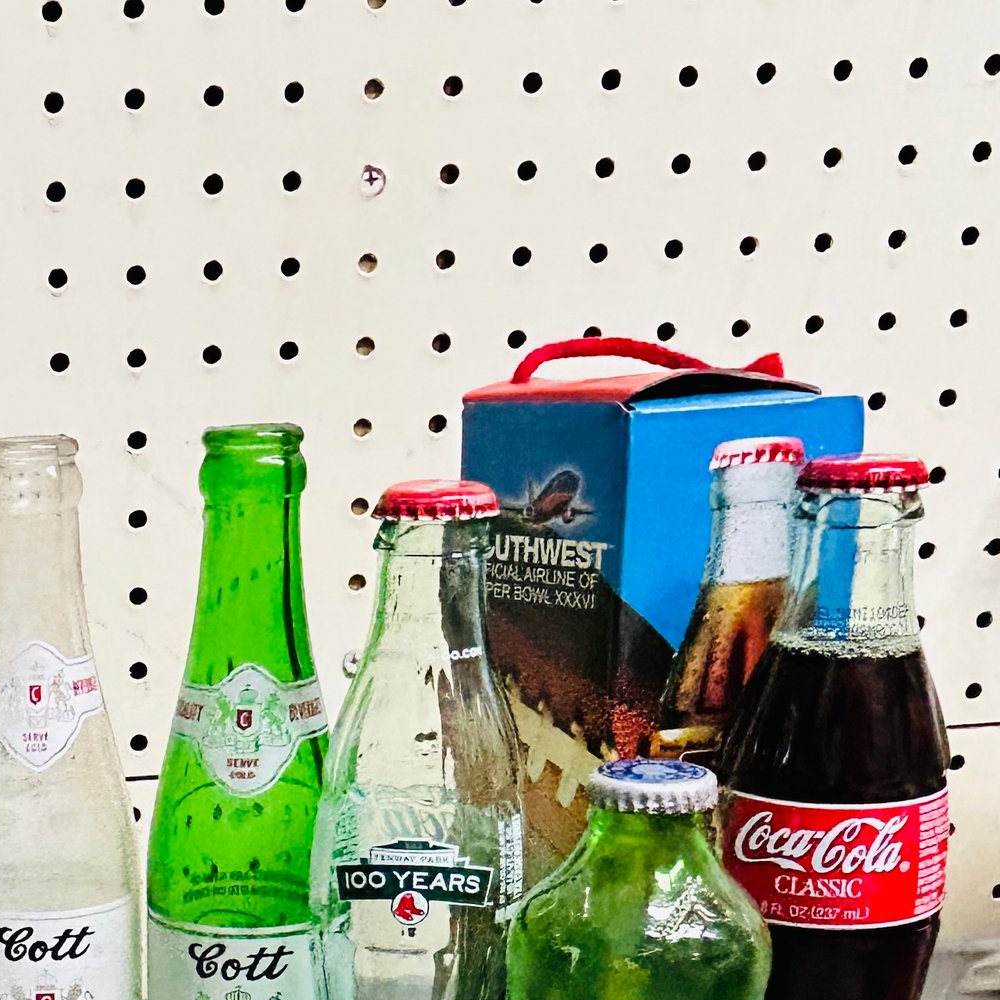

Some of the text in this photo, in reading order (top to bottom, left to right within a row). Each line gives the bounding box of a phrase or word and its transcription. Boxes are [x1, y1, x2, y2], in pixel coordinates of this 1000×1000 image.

[483, 534, 608, 570] UTHWEST
[485, 563, 599, 589] FICIAL AIRLINE OF
[485, 581, 595, 609] PER BOWL XXXVI
[735, 811, 908, 874] Coca-Cola
[344, 870, 481, 894] 100 YEARS
[774, 875, 863, 898] CLASSIC
[188, 942, 295, 981] Cott
